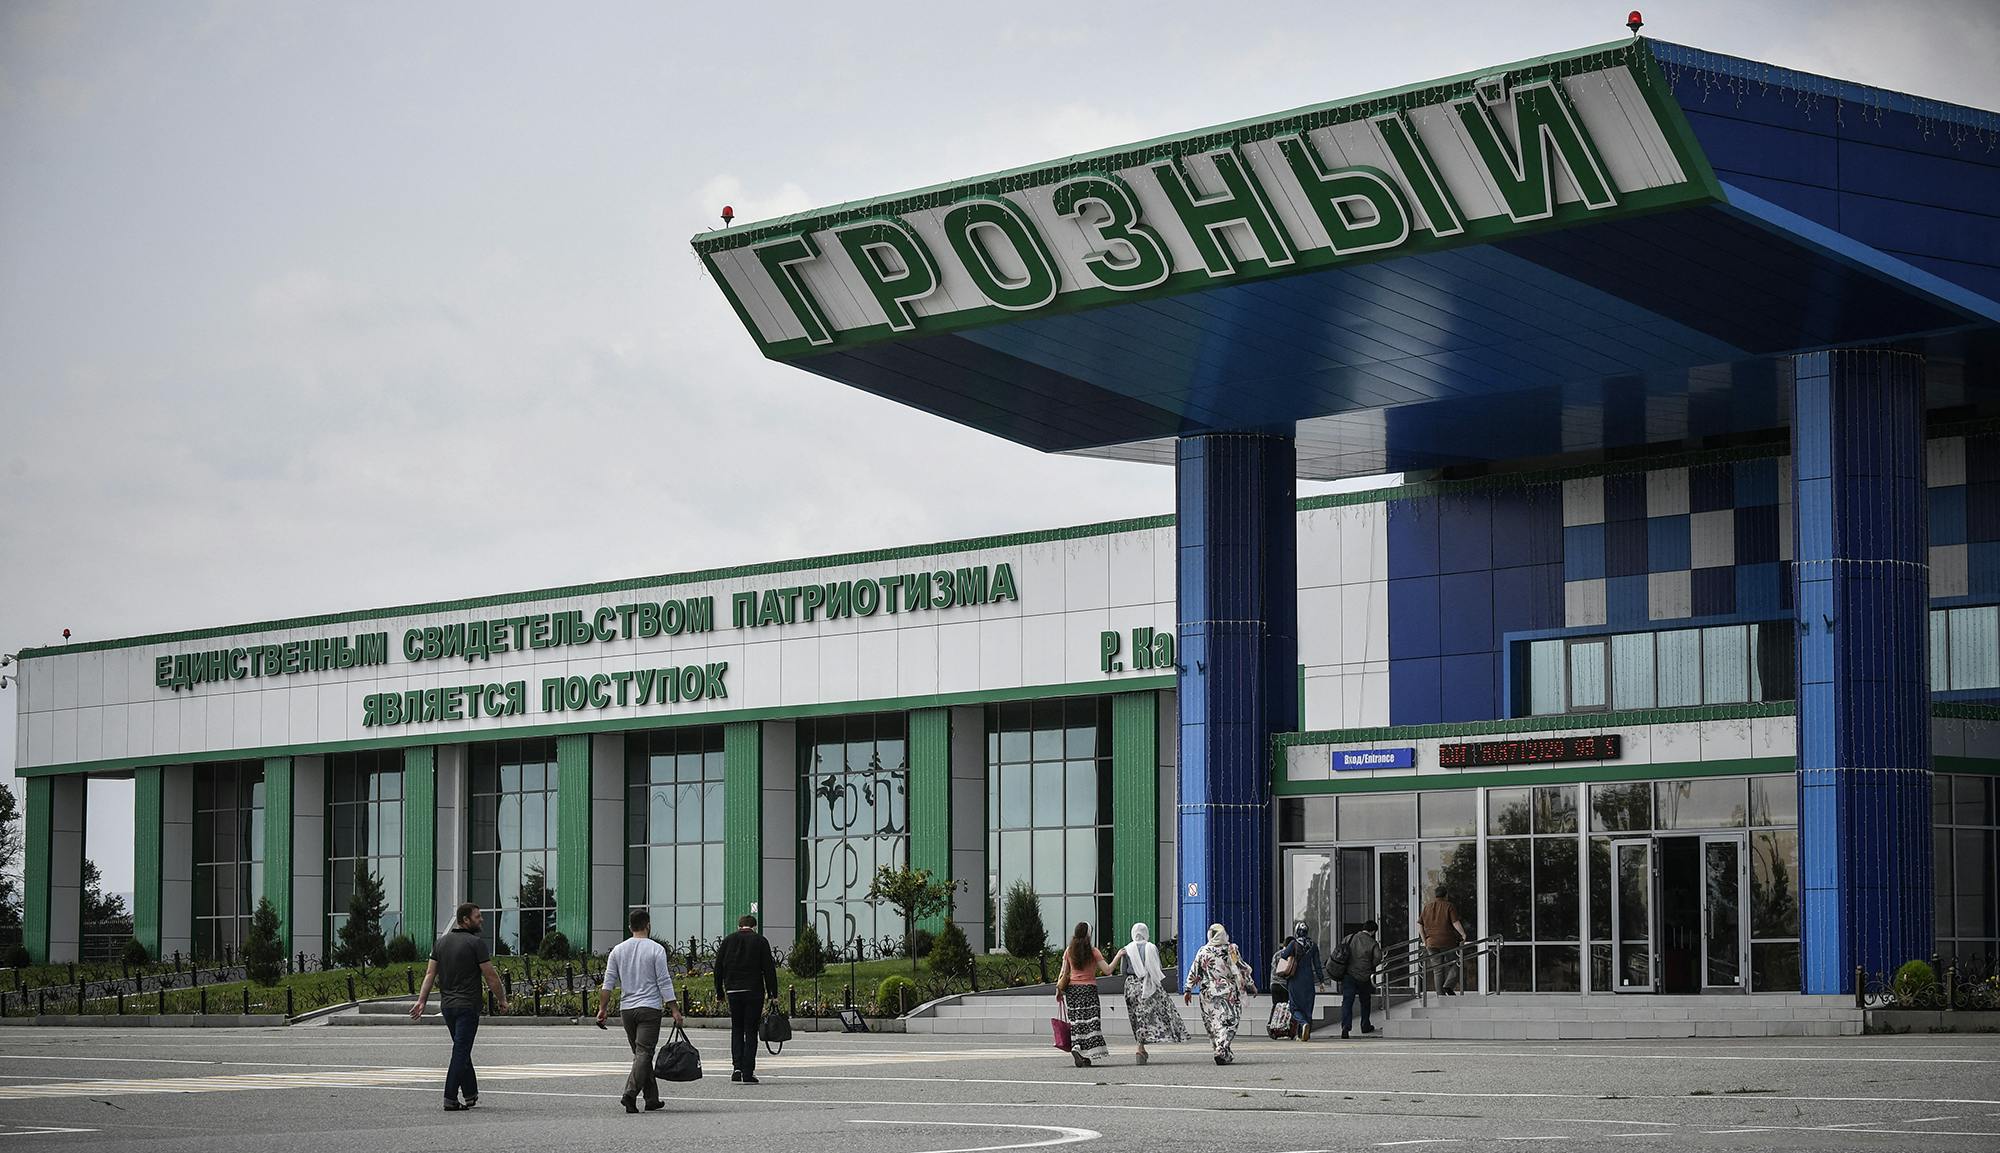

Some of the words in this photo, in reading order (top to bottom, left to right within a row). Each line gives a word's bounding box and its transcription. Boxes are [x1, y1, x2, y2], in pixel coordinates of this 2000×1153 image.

[753, 73, 1618, 347] ГРОЗНЫЙ
[155, 631, 387, 691] ЕДИНСТВЕННЫМ
[402, 595, 714, 662] СВИДЕТЕЛЬСТВОМ
[732, 562, 1018, 630] ПАТРИОТИЗМА
[1100, 630, 1123, 673] Р.
[362, 680, 526, 727] ЯВЛЯЕТСЯ
[541, 661, 729, 713] ПОСТУПОК
[1344, 753, 1395, 766] Вход/Entrance
